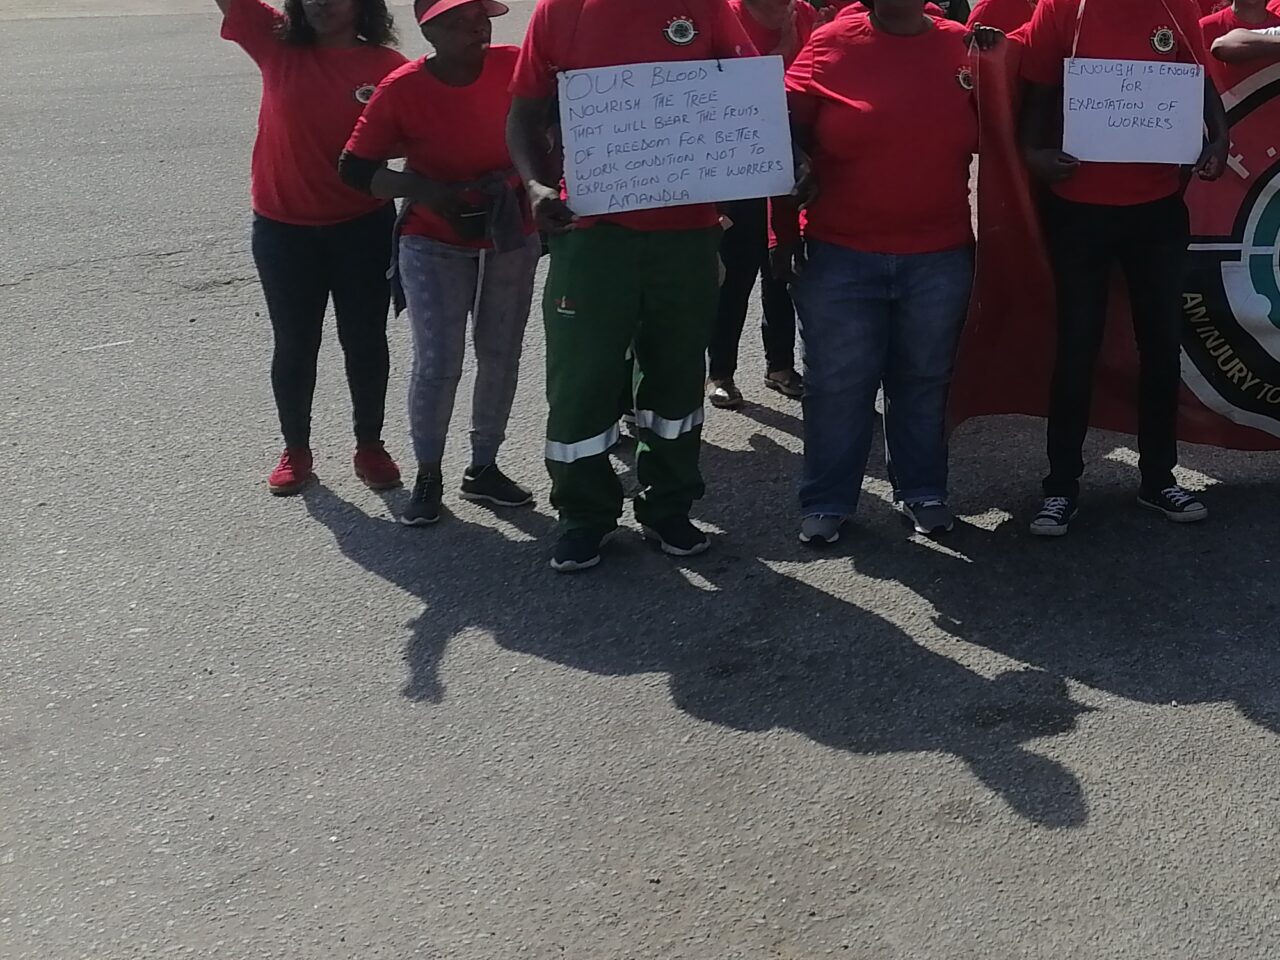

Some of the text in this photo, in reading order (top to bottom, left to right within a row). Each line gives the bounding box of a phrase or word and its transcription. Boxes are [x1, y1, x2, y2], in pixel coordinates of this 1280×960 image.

[565, 66, 708, 101] OUR BLOOD
[1068, 63, 1134, 77] ENOUGH
[1143, 65, 1153, 74] IS
[1121, 78, 1143, 92] FOR
[568, 90, 718, 121] NOURISH THE TREE
[1068, 98, 1179, 111] EXPLOTATION OF
[569, 124, 603, 142] THAT
[614, 120, 646, 134] WILL
[655, 115, 690, 129] BEAR
[696, 106, 717, 123] THE
[1108, 116, 1173, 130] WORKERS
[575, 146, 596, 165] OF
[680, 131, 706, 148] FOR
[715, 127, 760, 144] BETTER
[576, 143, 765, 180] WORK CONDITION NOT TO
[576, 175, 660, 196] EXPLOTATION
[667, 168, 690, 183] OF
[699, 166, 717, 179] THE
[608, 189, 690, 211] AMANDLA
[1182, 292, 1210, 323] AN
[1196, 326, 1260, 391] INJURY
